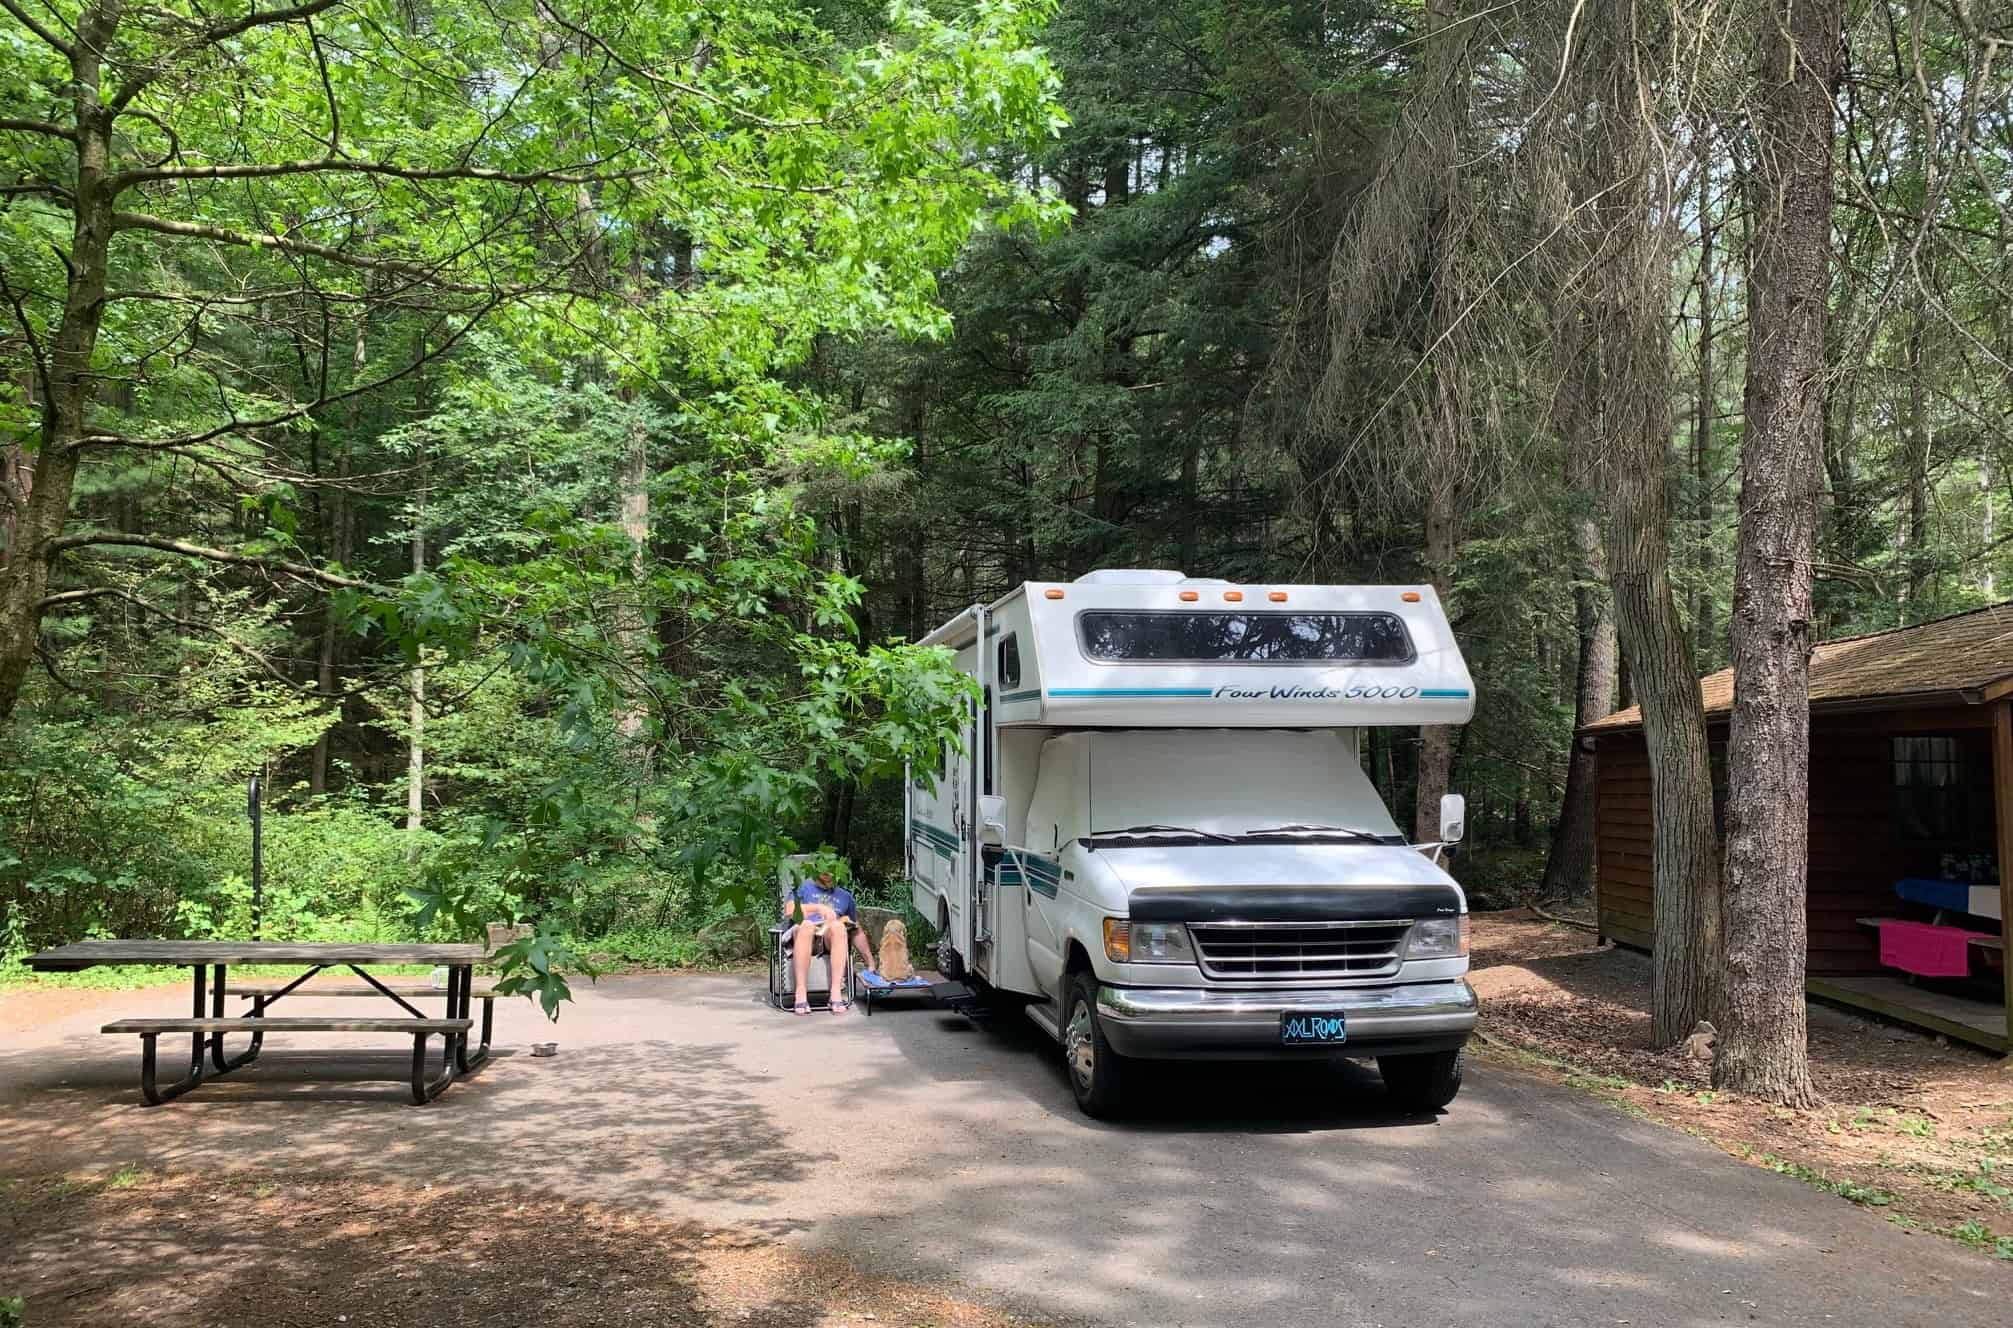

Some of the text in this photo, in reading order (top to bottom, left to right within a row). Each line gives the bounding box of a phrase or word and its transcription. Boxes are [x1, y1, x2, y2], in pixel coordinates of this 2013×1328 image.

[1215, 685, 1419, 699] Four Winds 5000
